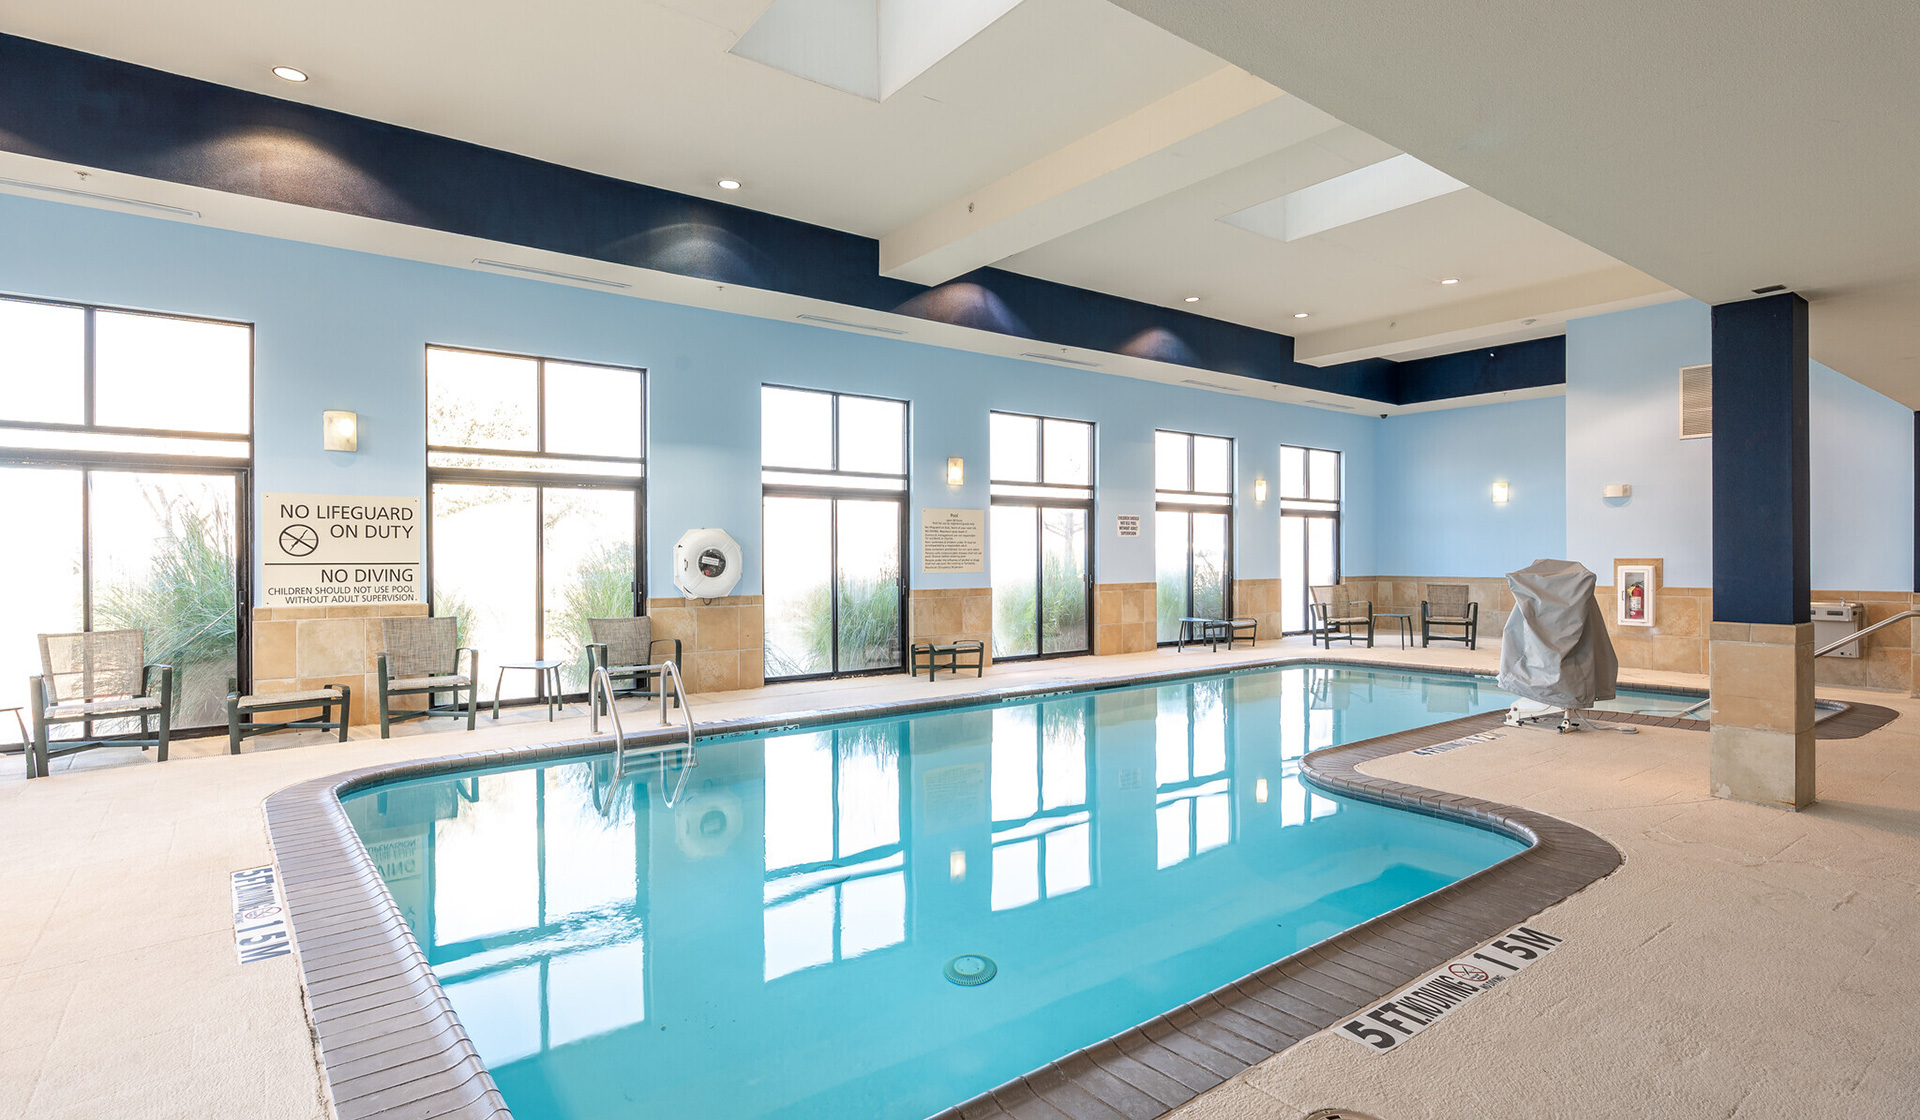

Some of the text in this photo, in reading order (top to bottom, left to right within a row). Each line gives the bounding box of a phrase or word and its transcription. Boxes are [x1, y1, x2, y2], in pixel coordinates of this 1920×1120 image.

[280, 504, 414, 521] NO LIFEGUARD
[330, 524, 414, 539] ON DUTY
[321, 569, 413, 583] NO DIVING
[268, 587, 312, 596] CHILDREN
[314, 586, 351, 595] SHOULD
[354, 586, 372, 594] NOT
[285, 596, 328, 604] WITHOUT
[331, 595, 359, 603] ADULT
